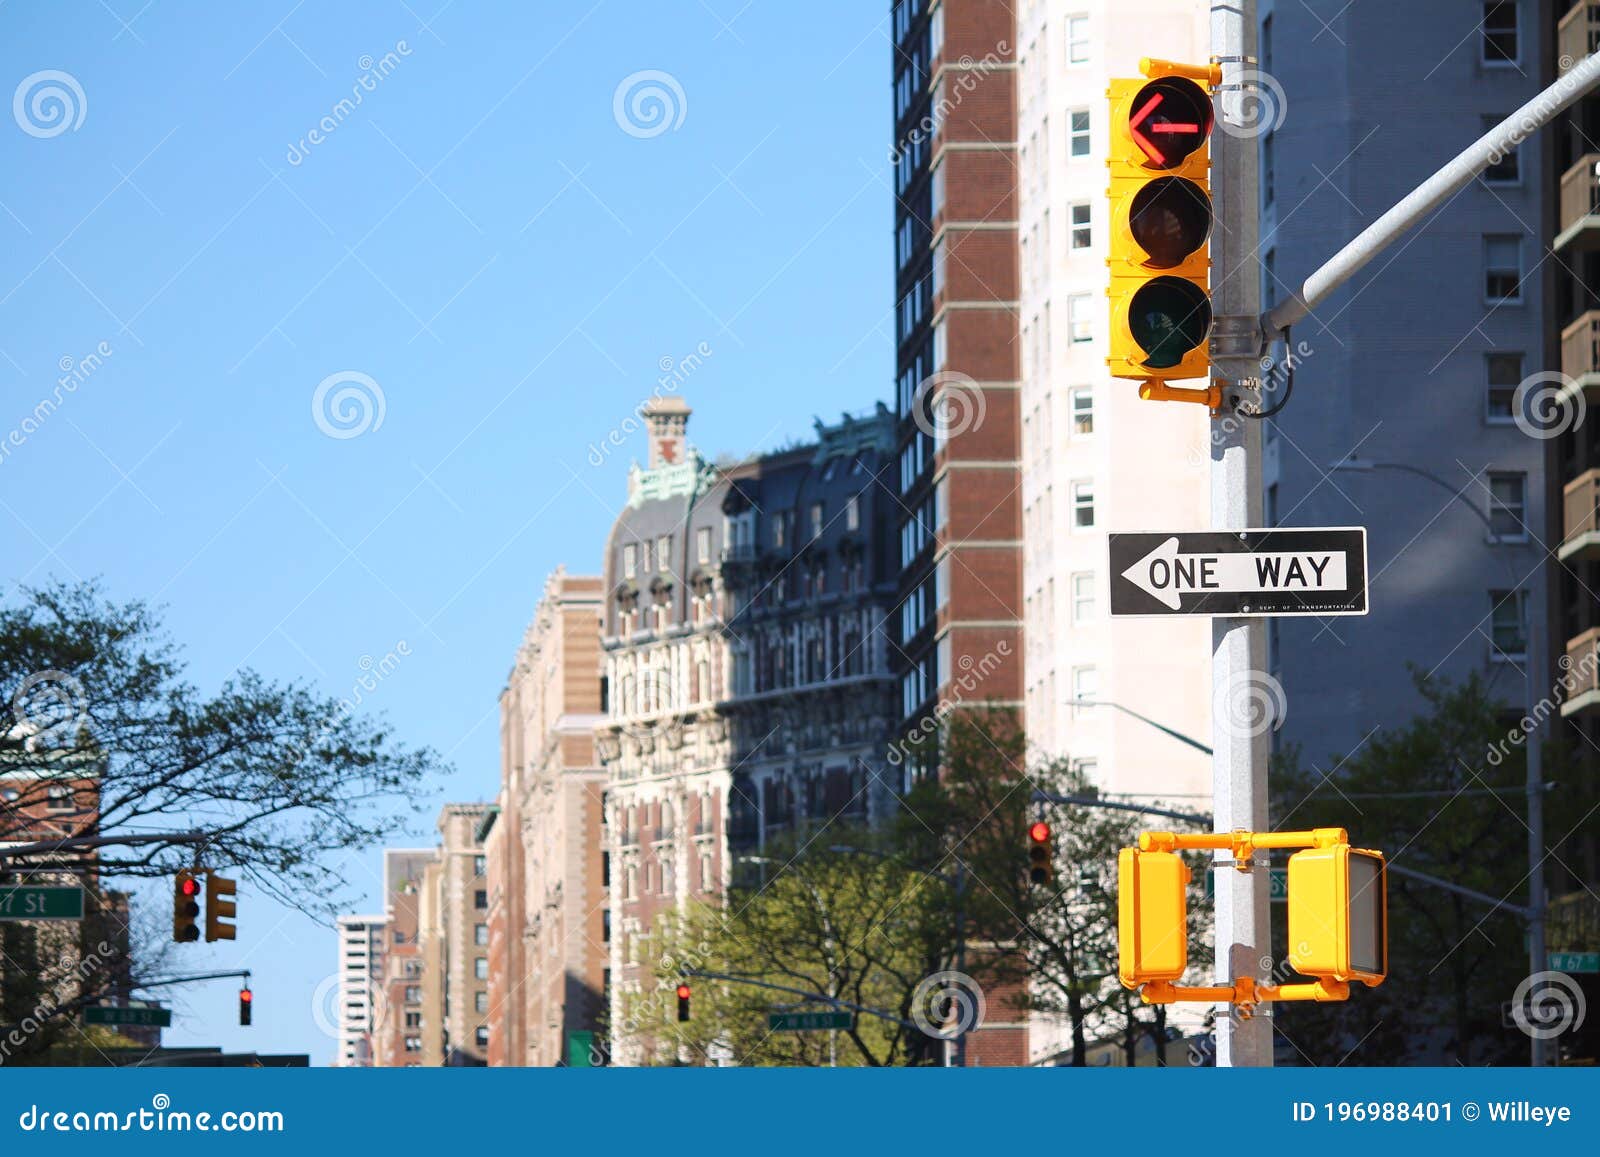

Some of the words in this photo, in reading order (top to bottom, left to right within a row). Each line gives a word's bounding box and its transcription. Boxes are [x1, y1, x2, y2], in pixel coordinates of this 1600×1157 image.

[1149, 557, 1219, 590] ONE
[1255, 556, 1331, 588] WAY
[0, 893, 15, 913] 7
[24, 893, 47, 913] St
[1551, 955, 1562, 969] W
[1567, 954, 1584, 970] 67
